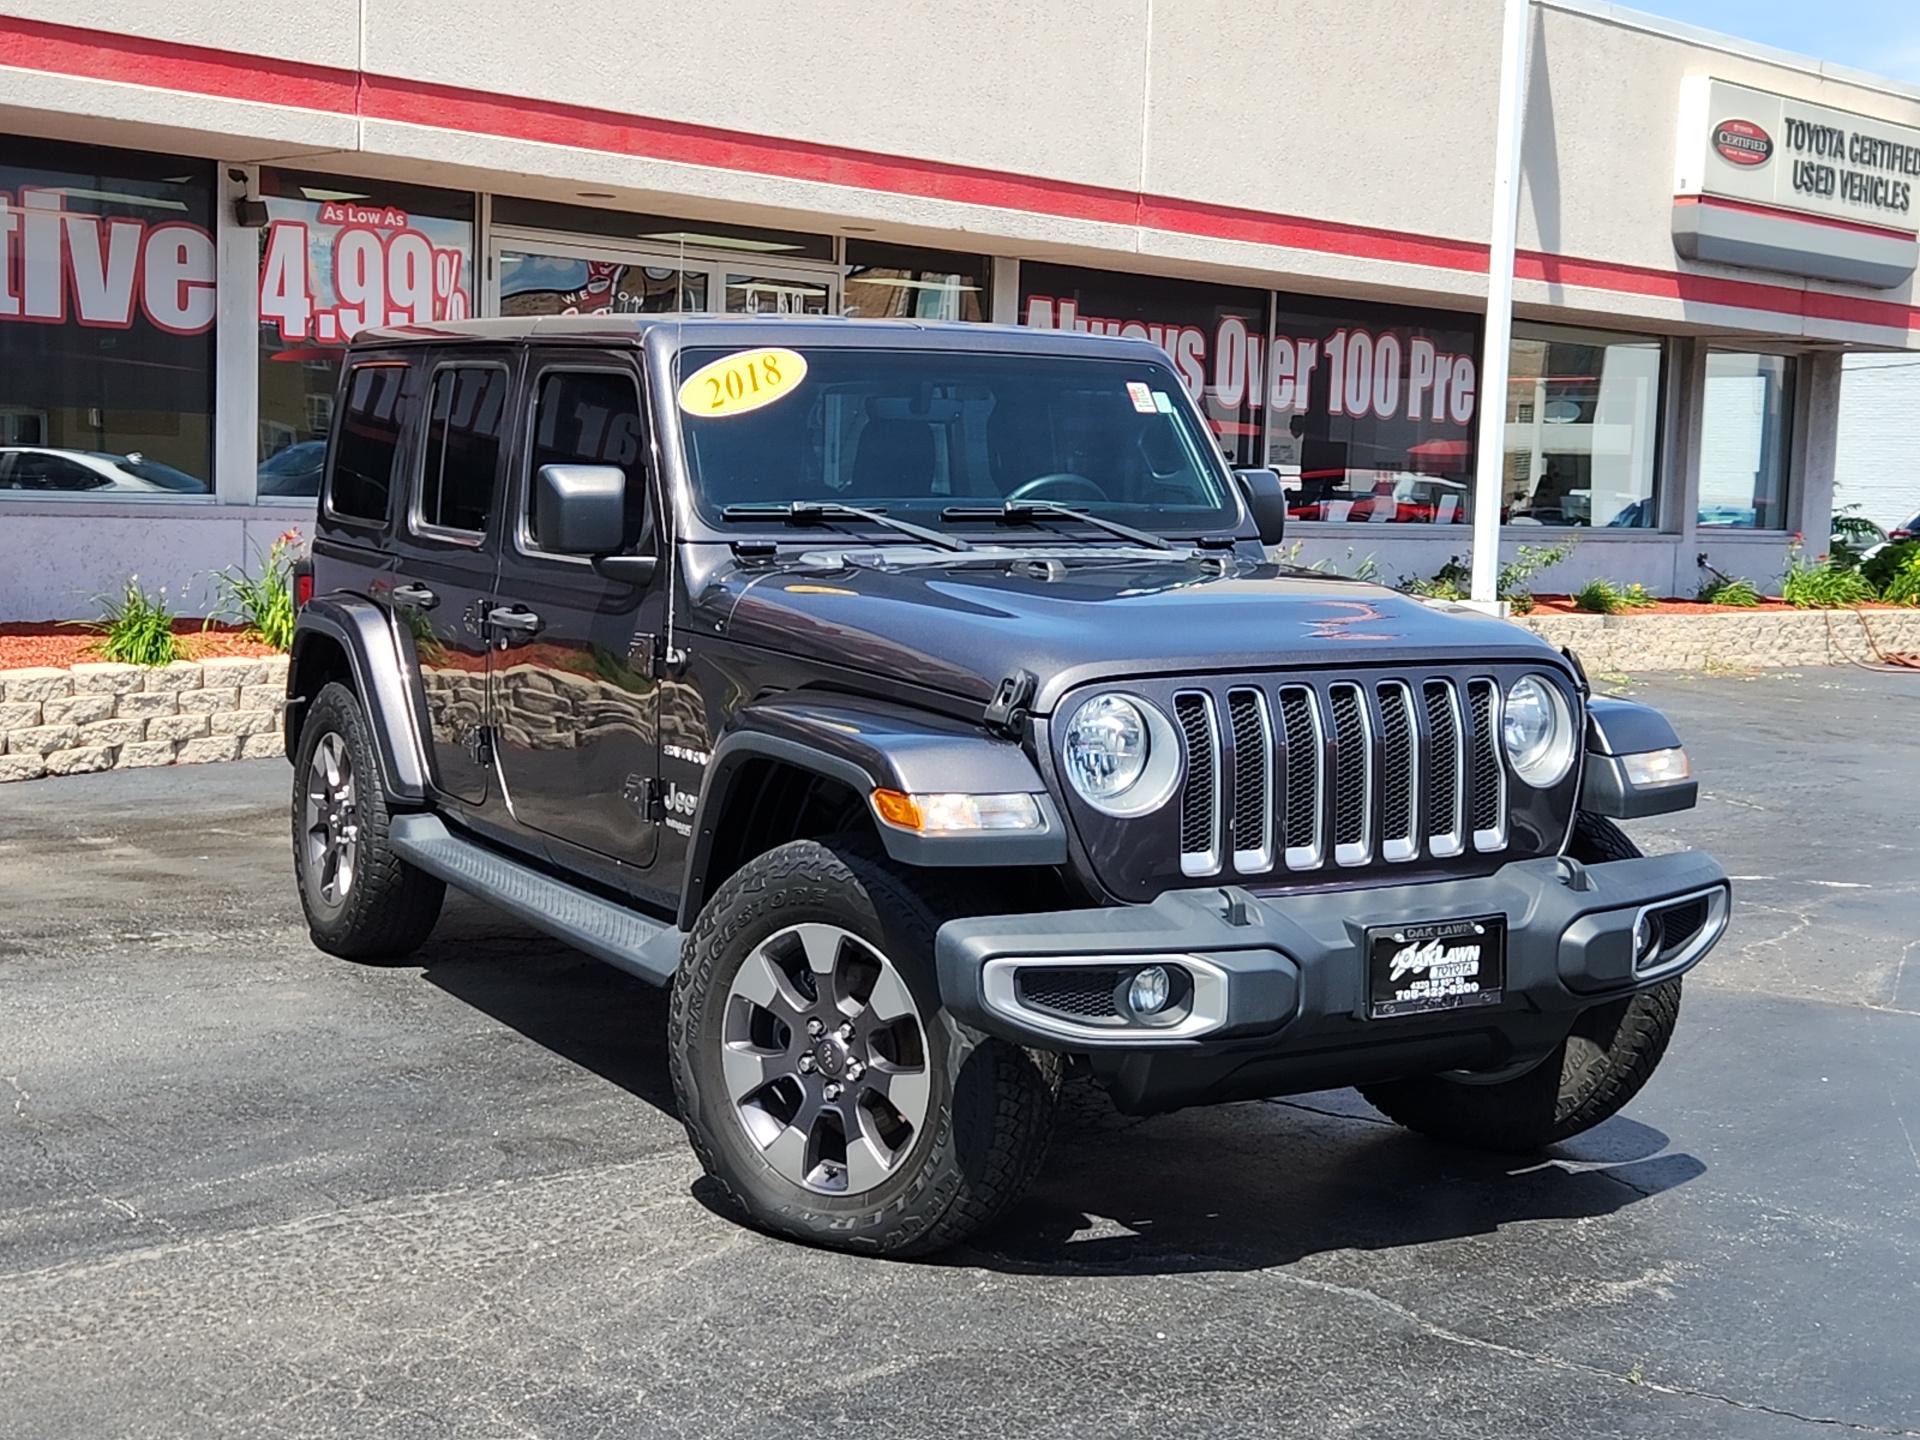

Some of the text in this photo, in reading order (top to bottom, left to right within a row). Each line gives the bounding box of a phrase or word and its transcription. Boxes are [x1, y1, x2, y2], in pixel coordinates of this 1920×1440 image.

[1719, 131, 1767, 152] CERTIFIED
[1784, 117, 1920, 176] TOYOTA CERTIFIED
[1793, 160, 1911, 212] USED VEHICLES
[323, 206, 404, 226] As Low As
[704, 354, 783, 408] 2018
[1326, 330, 1401, 418] 100
[1408, 339, 1475, 424] Pre
[664, 782, 698, 816] Jee
[1407, 927, 1434, 938] OAK
[686, 887, 828, 1046] BRIDGESTONE
[1435, 963, 1473, 976] TOYOTA
